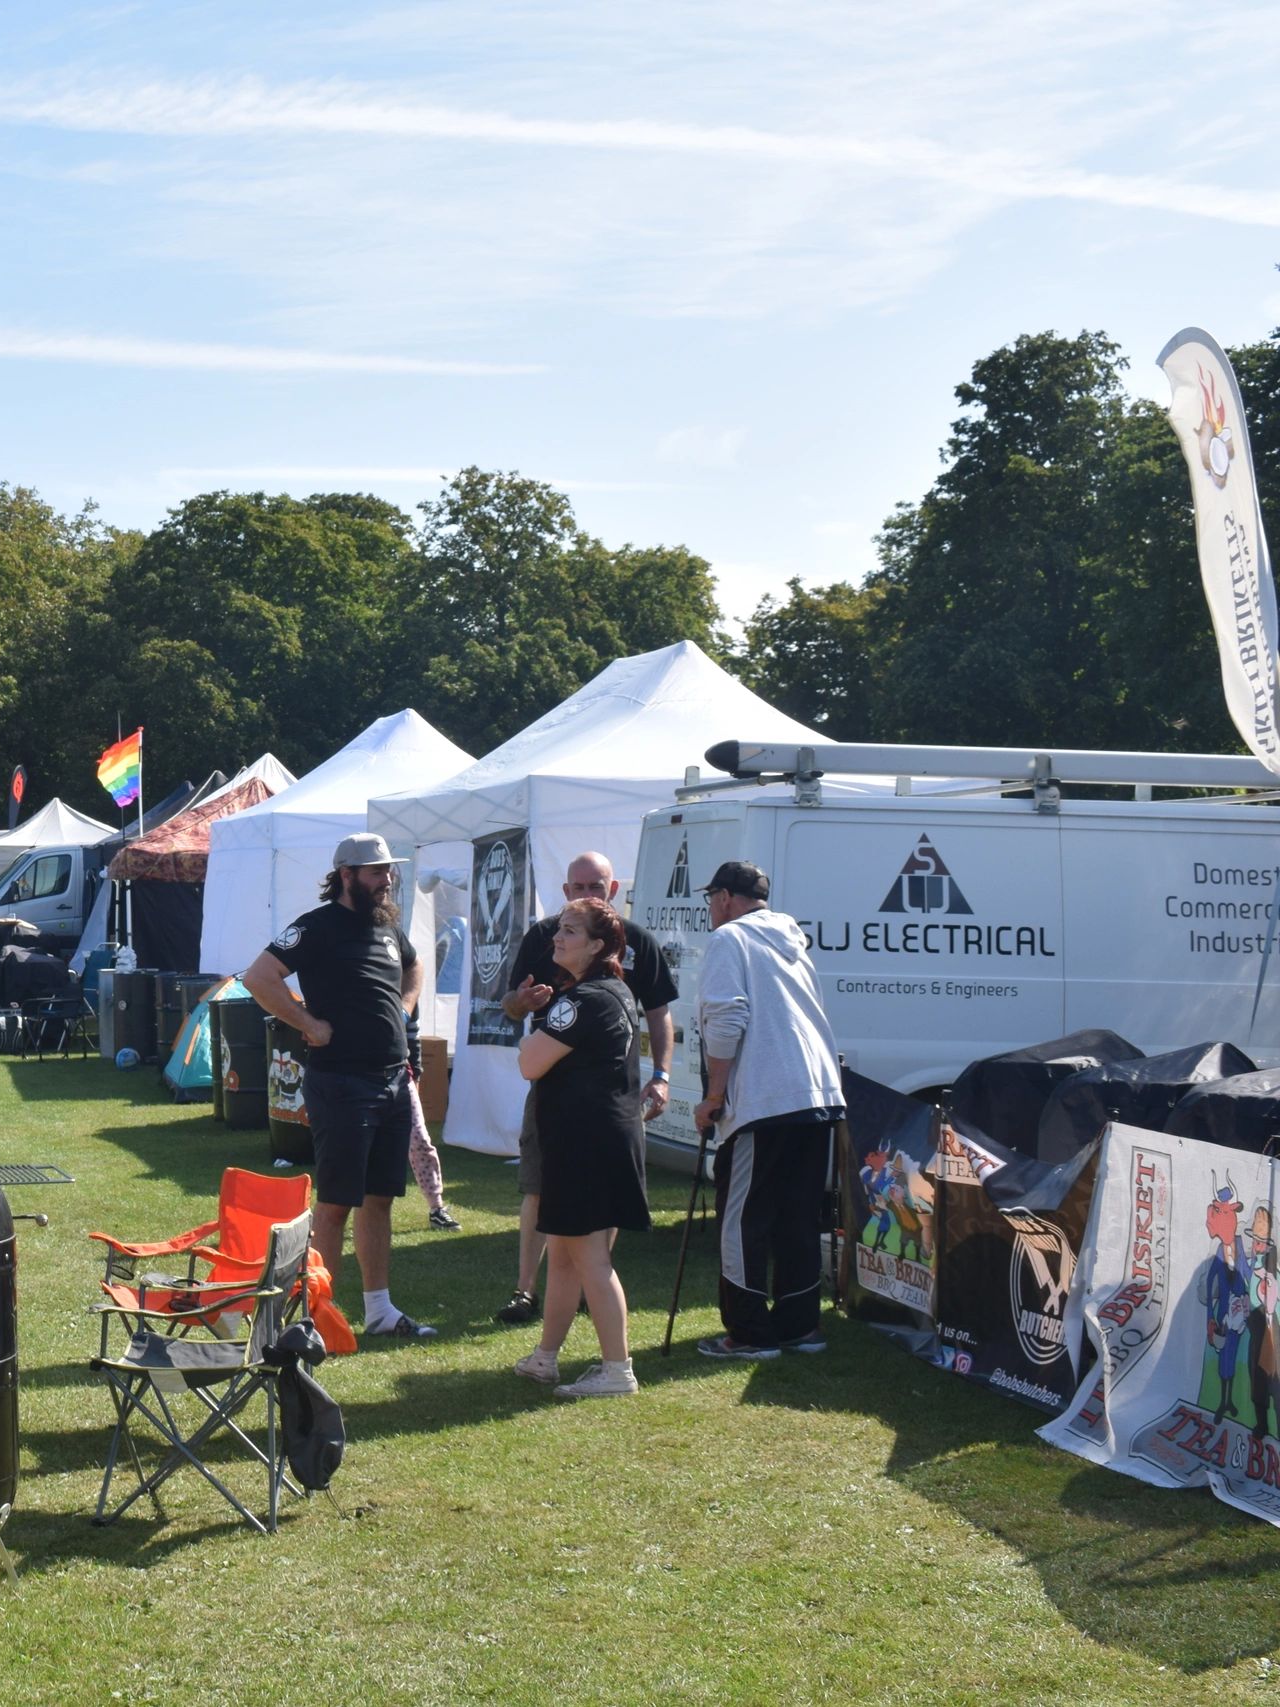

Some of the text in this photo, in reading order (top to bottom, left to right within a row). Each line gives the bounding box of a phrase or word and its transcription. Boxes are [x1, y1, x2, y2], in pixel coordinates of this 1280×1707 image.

[863, 922, 1055, 957] ELECTRICAL
[836, 978, 1019, 999] Contractors & Engineers
[1097, 1153, 1156, 1328] BRISKET
[857, 1246, 887, 1276] TEA
[1144, 1223, 1167, 1311] TEAM
[877, 1275, 898, 1300] BBQ
[944, 1326, 956, 1338] us
[988, 1367, 1062, 1407] @bobsbutchers
[1157, 1406, 1228, 1468] TEA
[1231, 1433, 1246, 1470] &
